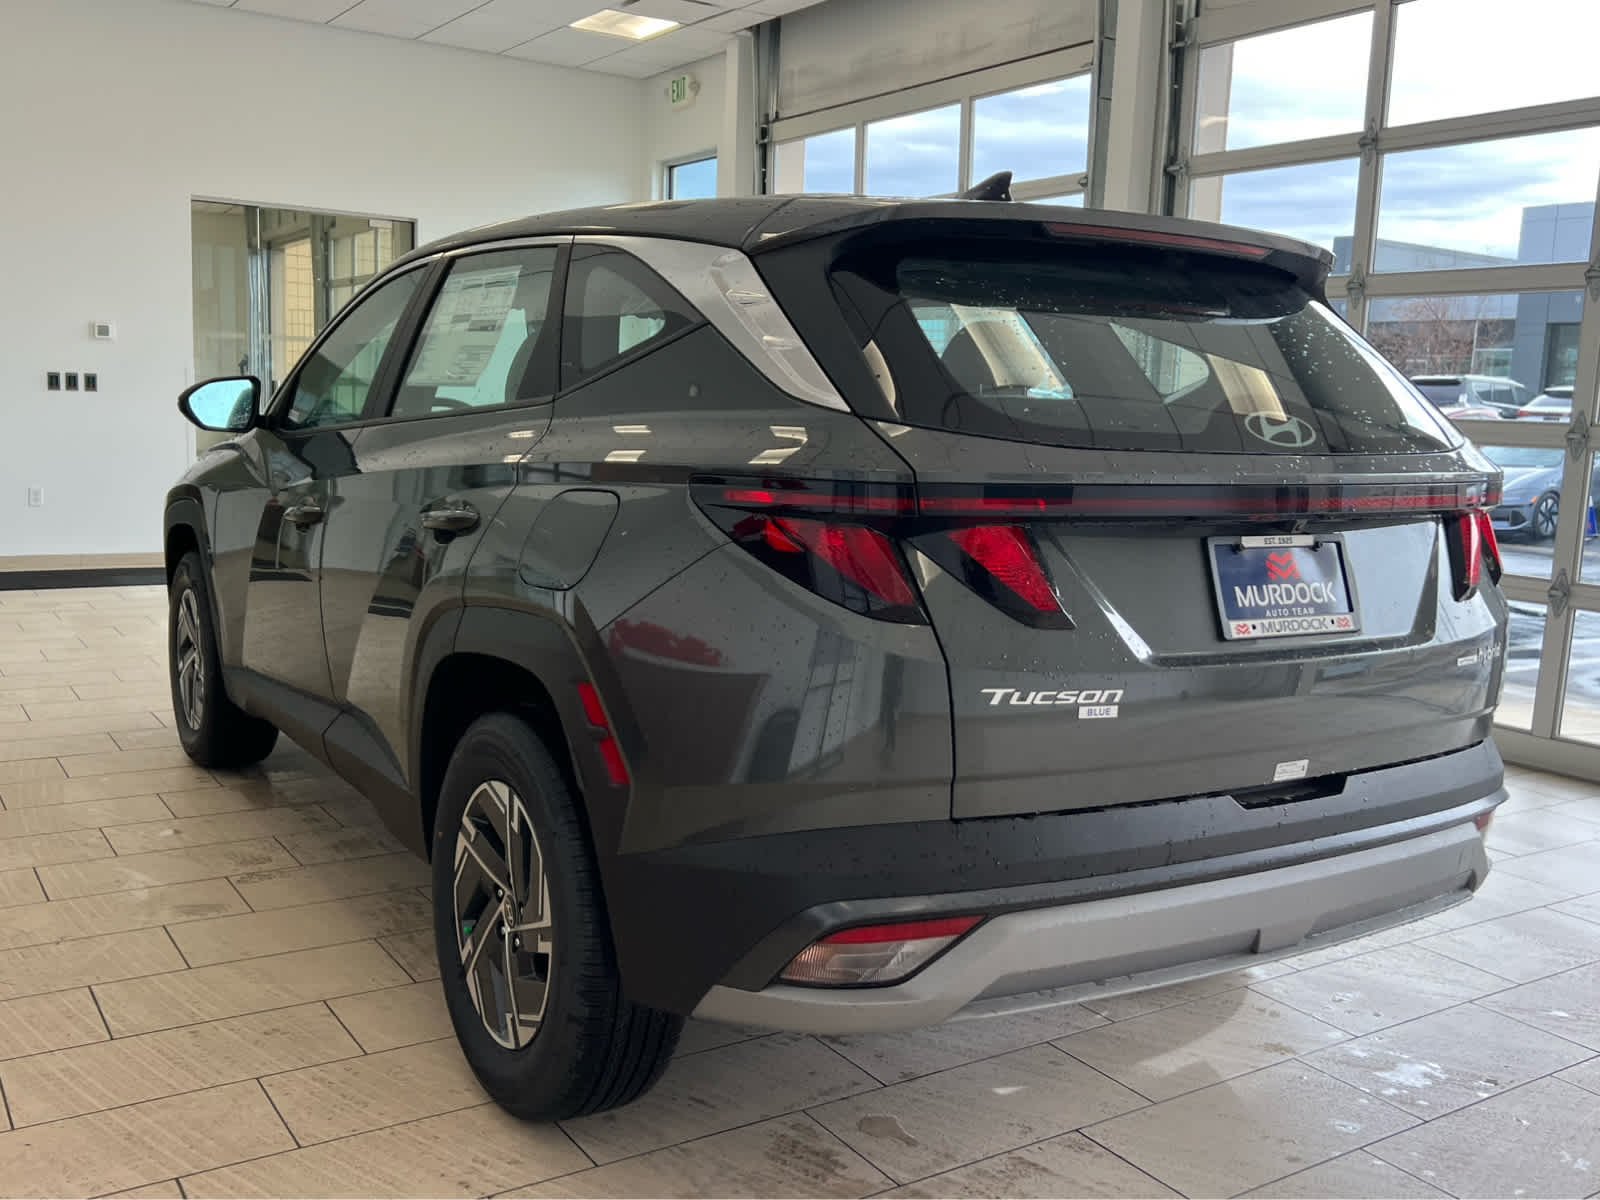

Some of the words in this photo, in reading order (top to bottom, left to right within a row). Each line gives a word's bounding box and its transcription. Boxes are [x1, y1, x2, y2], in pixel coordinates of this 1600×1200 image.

[671, 76, 686, 103] EXIT
[1234, 581, 1337, 608] MURDOCK
[1265, 608, 1289, 617] AUTO
[1292, 607, 1315, 616] TEAM
[1260, 618, 1329, 634] MURDOCK
[1087, 707, 1112, 717] BLUE
